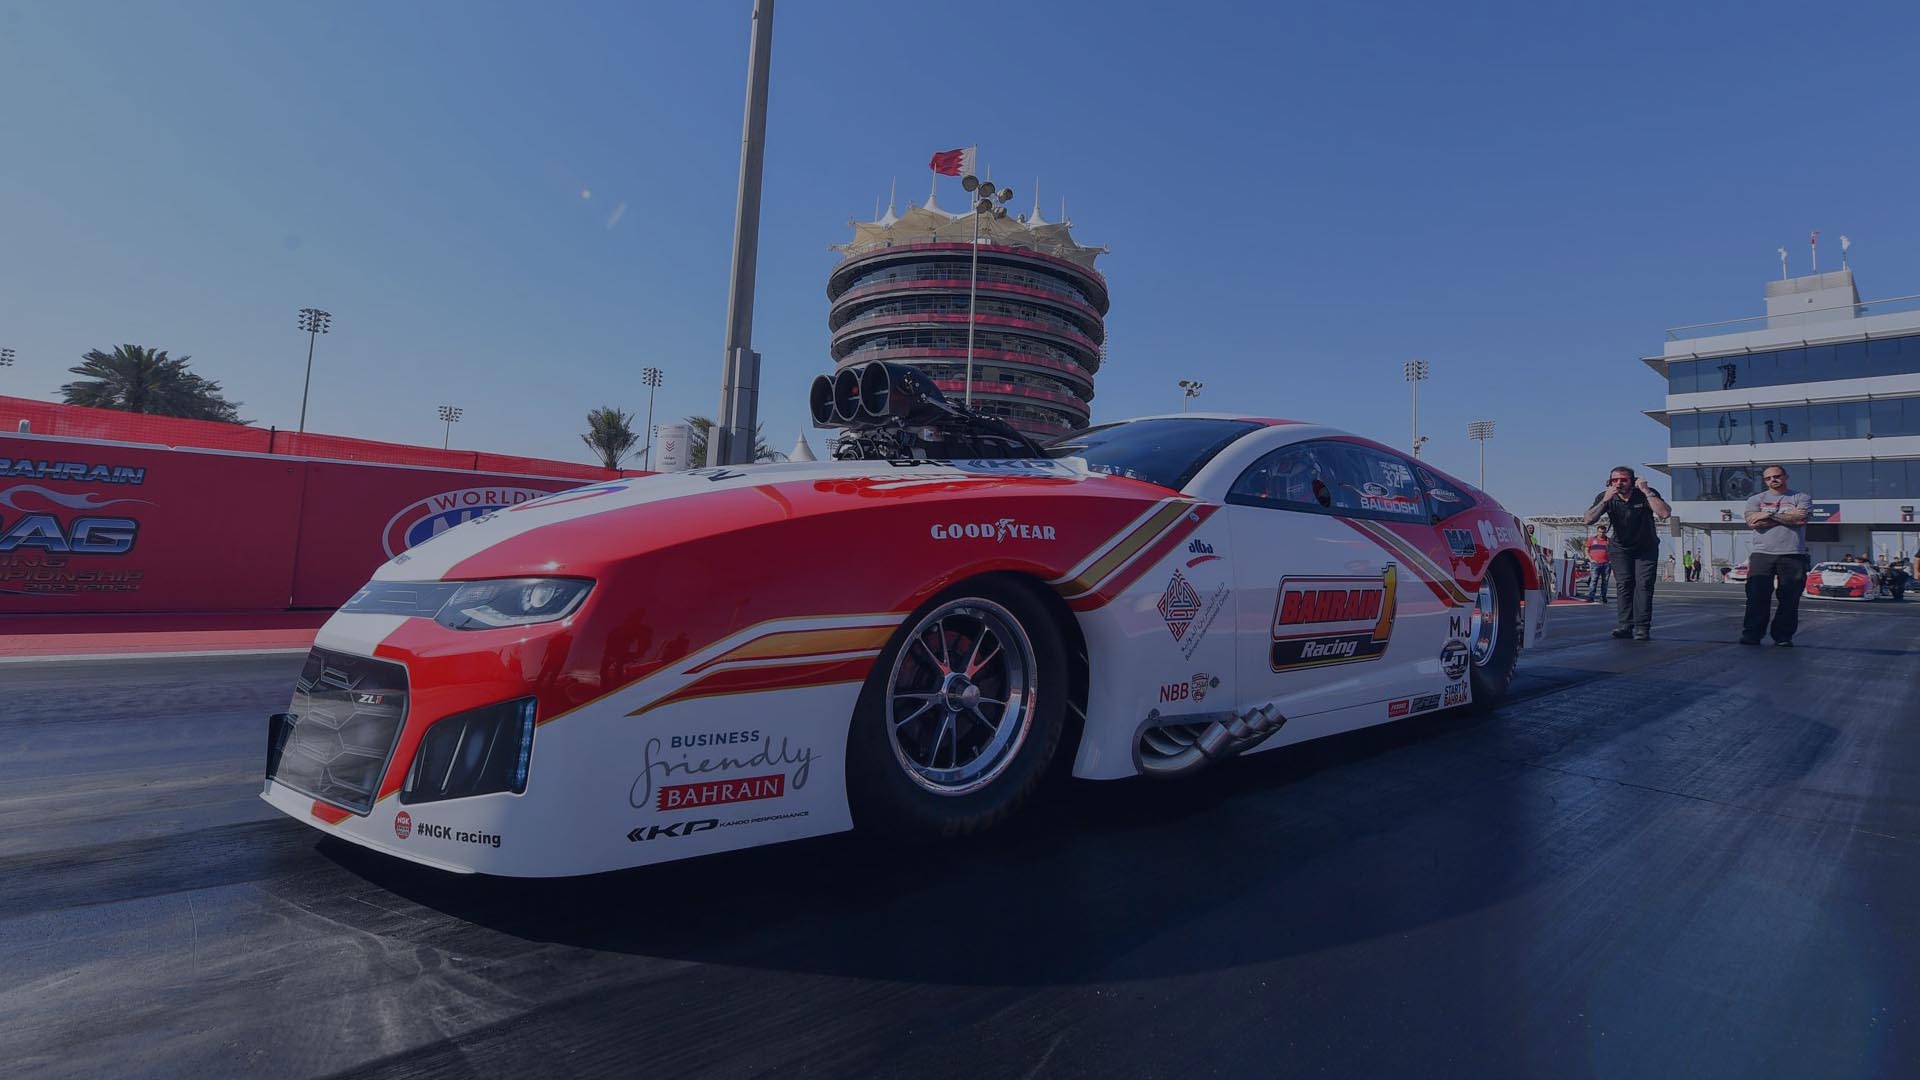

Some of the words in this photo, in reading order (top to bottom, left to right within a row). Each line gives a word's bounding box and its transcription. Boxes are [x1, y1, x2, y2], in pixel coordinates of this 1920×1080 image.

[0, 512, 139, 554] AG
[1279, 590, 1383, 625] BAHRAIN
[1301, 640, 1358, 658] Racing
[1159, 682, 1189, 703] NBB
[671, 730, 760, 748] BUSINESS
[630, 736, 822, 809] friendly
[667, 779, 779, 807] BAHRAIN
[751, 811, 809, 824] PERFORMANCE
[417, 822, 452, 840] #NGK
[456, 830, 501, 848] racing
